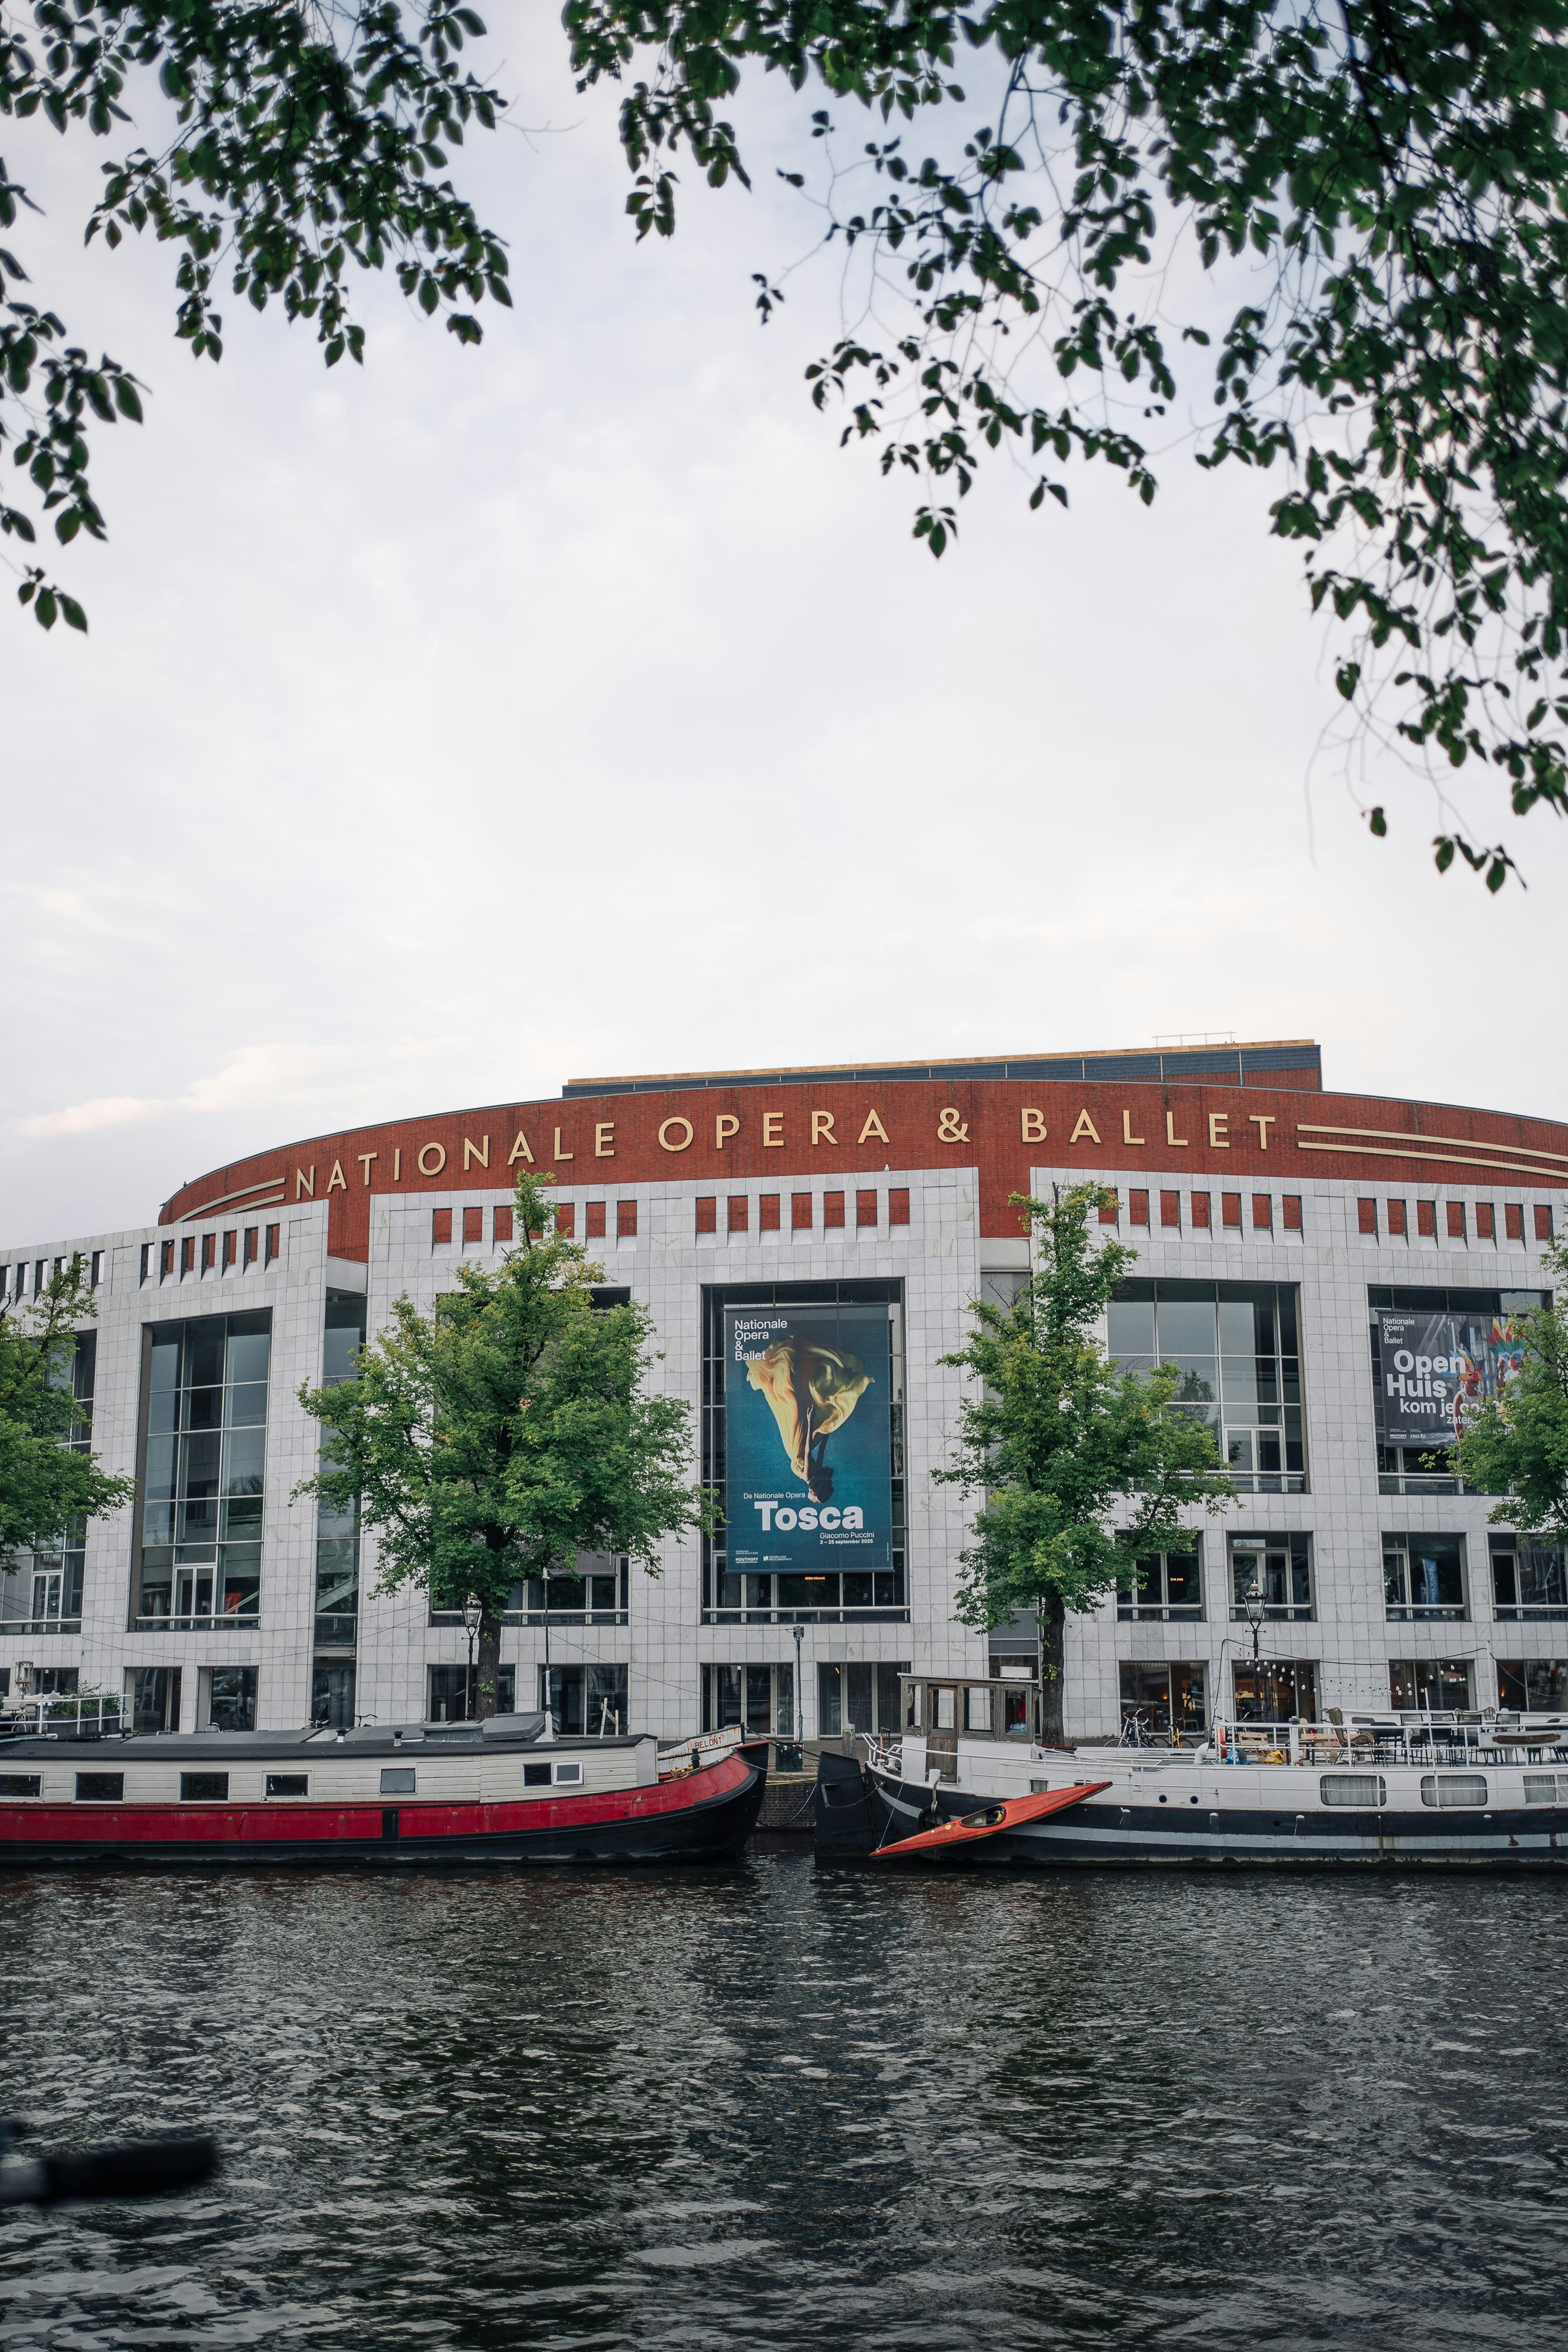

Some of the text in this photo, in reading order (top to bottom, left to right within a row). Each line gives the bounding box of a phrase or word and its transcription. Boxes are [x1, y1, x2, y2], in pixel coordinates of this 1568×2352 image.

[296, 1107, 1275, 1199] NATIONALE OPERA & BALLET
[735, 1318, 787, 1330] Nationale
[1383, 1324, 1404, 1332] Opera
[734, 1330, 769, 1342] Opera
[735, 1341, 743, 1351] &
[735, 1350, 766, 1361] Ballet
[1393, 1349, 1466, 1379] Open
[1387, 1373, 1447, 1398] Huis
[1400, 1398, 1436, 1414] kom
[1439, 1398, 1454, 1418] je
[754, 1501, 863, 1531] Tosca
[694, 1736, 722, 1749] BELONT
